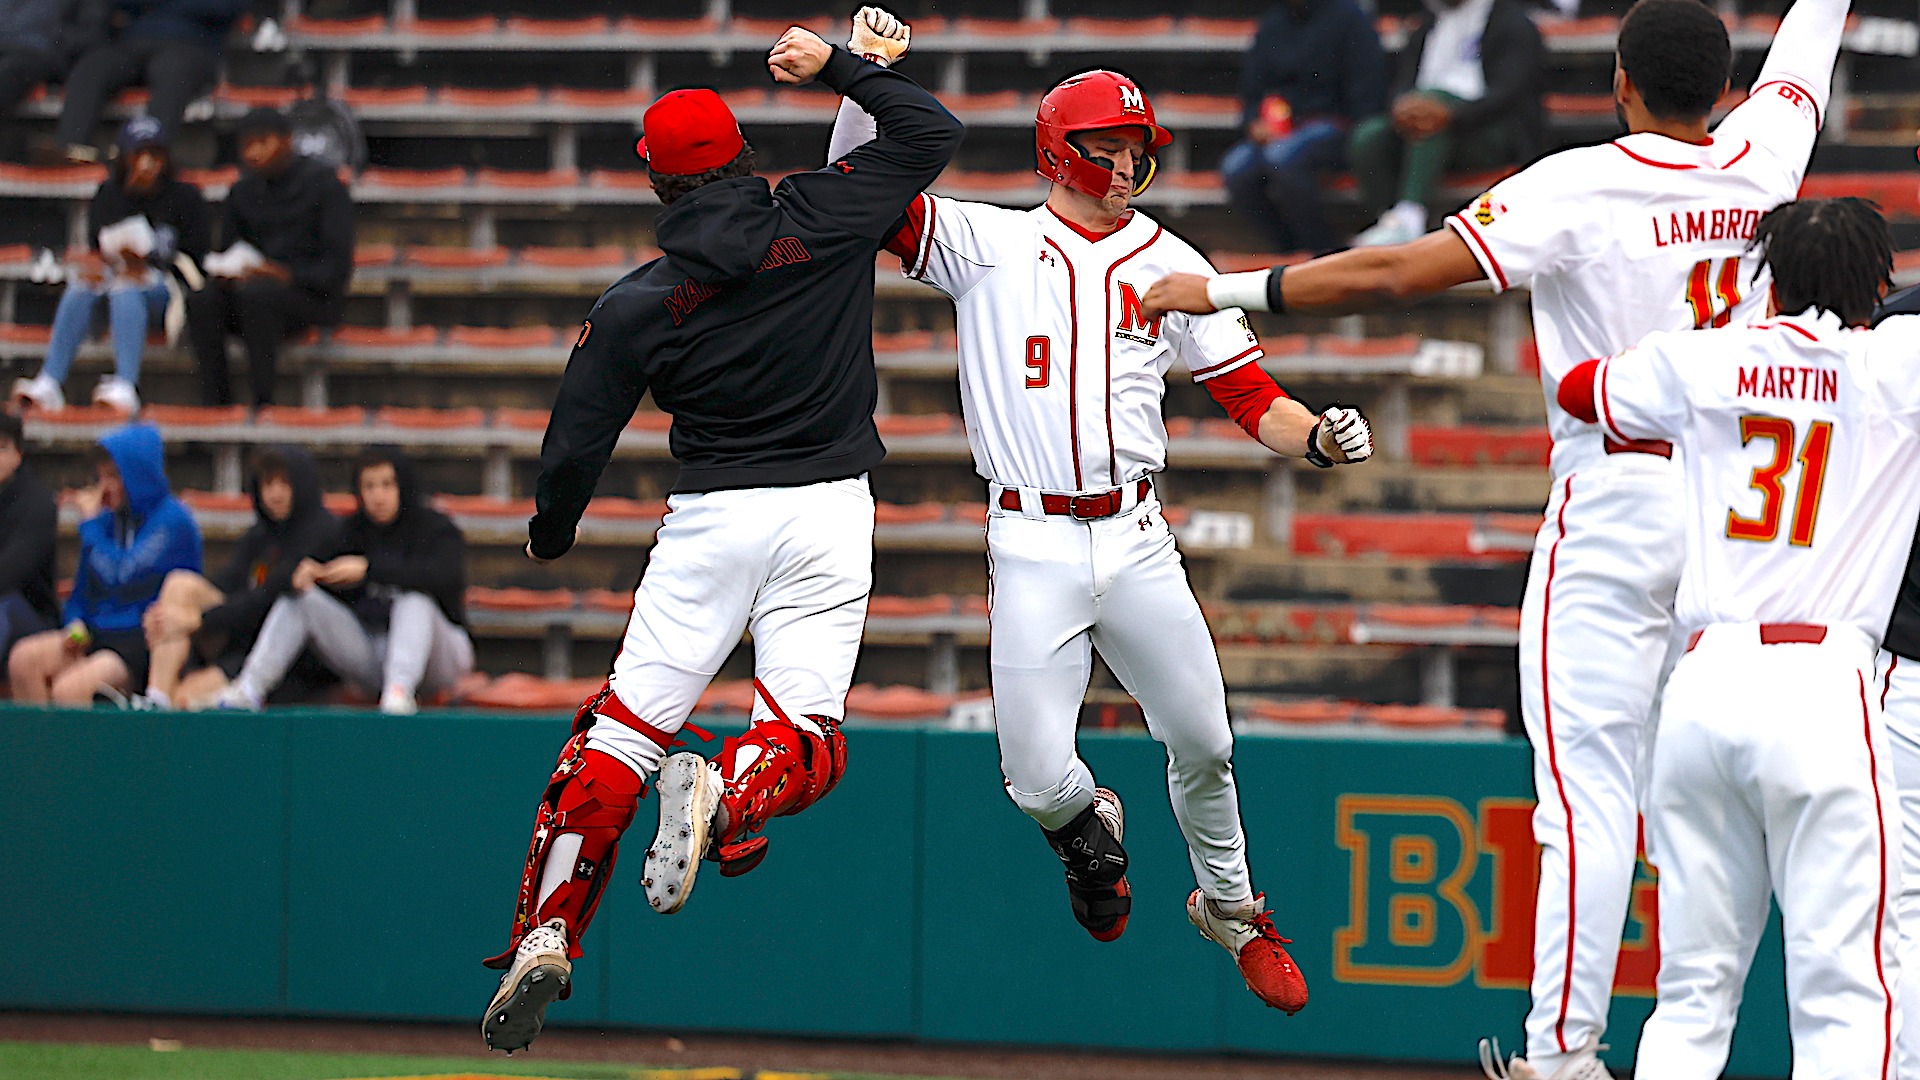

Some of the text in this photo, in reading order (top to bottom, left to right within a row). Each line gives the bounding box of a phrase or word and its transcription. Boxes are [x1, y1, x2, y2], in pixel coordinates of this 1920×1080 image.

[1119, 85, 1147, 111] M
[1652, 207, 1772, 248] LAMBRO
[1685, 256, 1742, 330] 11
[1025, 335, 1051, 389] 9
[1736, 365, 1838, 403] MARTIN
[1725, 415, 1834, 548] 31
